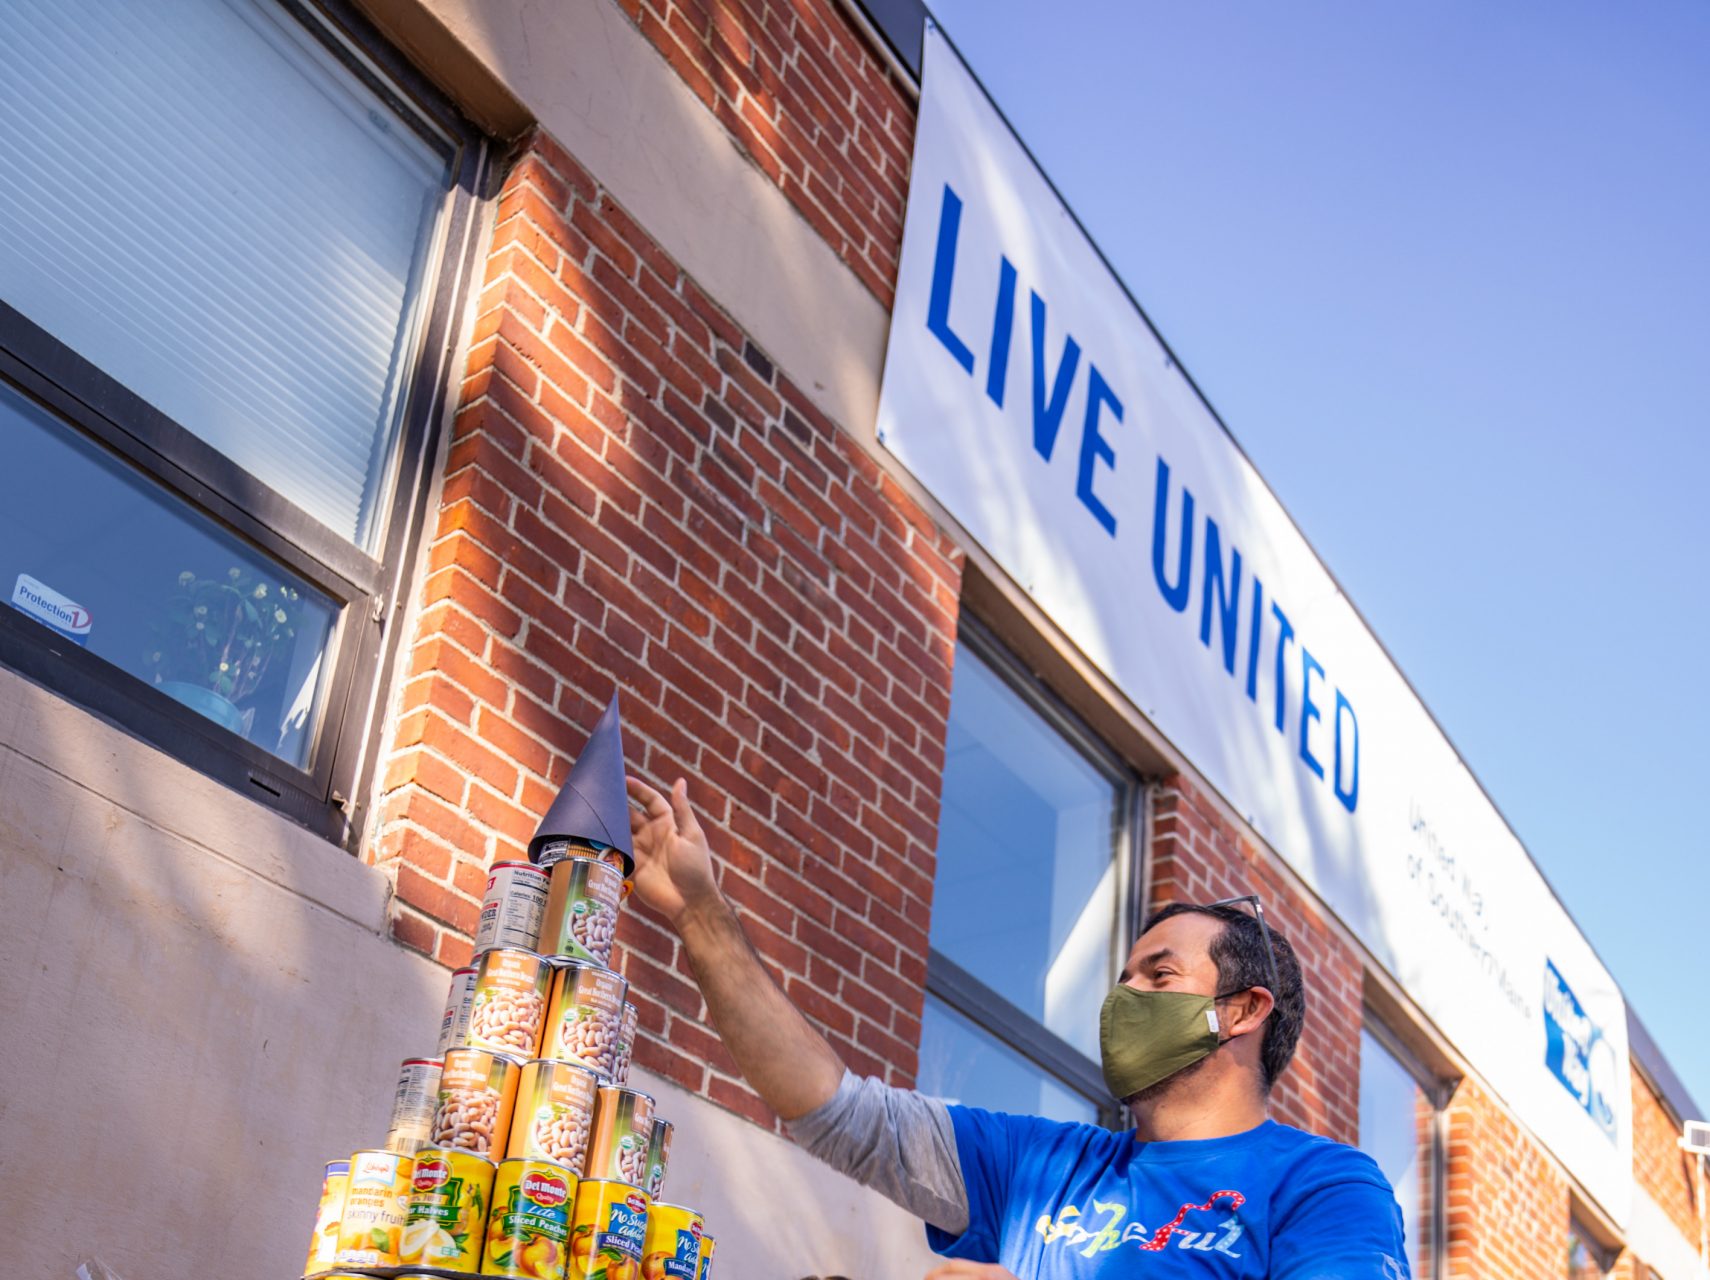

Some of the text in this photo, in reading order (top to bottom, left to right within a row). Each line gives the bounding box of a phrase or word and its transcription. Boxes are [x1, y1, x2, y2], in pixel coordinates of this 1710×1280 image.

[927, 182, 1358, 813] LIVE UNITED
[514, 870, 541, 882] Nutrition
[352, 1188, 392, 1198] mandarin
[524, 1180, 566, 1197] Del Monte
[419, 1205, 448, 1216] Halves
[526, 1205, 557, 1219] Lite
[611, 1209, 627, 1221] No
[509, 1215, 567, 1236] Sliced Peaches
[606, 1235, 630, 1247] Sliced
[678, 1236, 691, 1249] No
